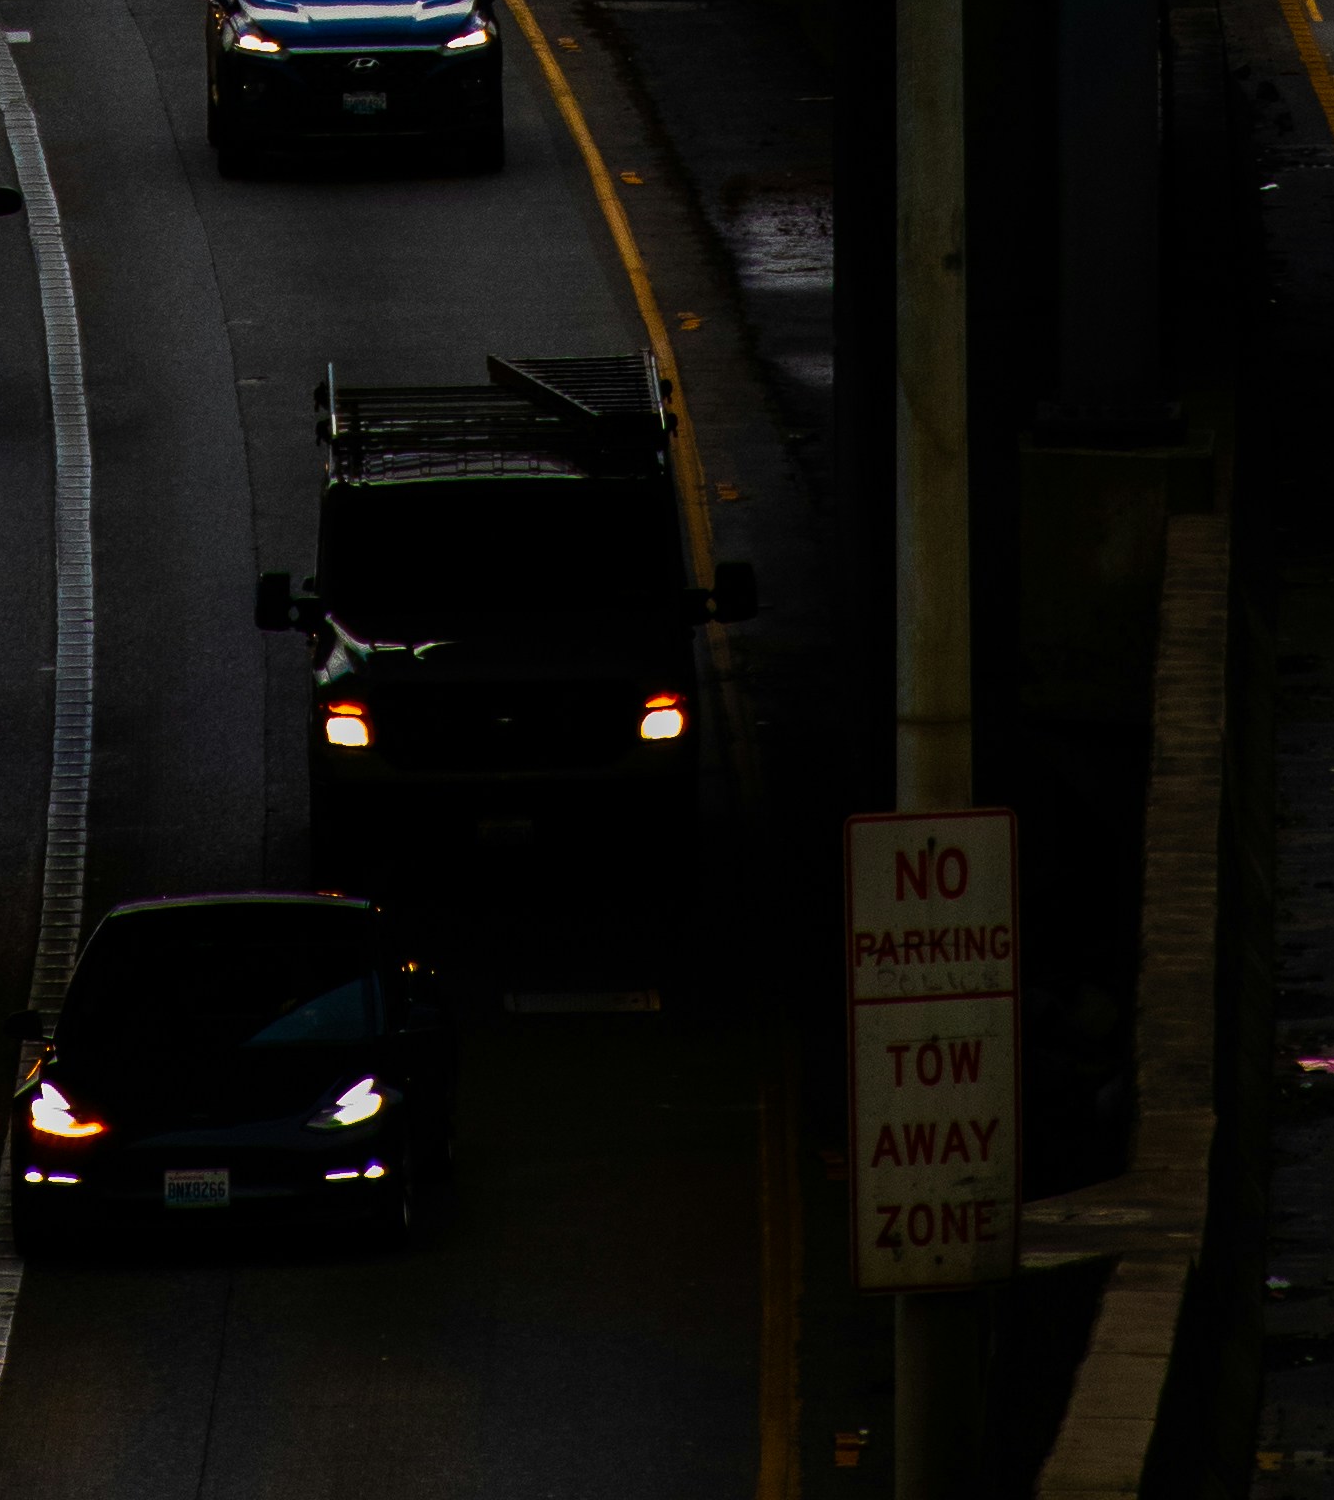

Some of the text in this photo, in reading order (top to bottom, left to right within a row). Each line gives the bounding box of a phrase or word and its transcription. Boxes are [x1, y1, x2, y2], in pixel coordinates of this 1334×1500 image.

[895, 848, 969, 900] NO
[854, 924, 1011, 968] PARKING
[886, 1040, 981, 1088] TOW
[871, 1118, 1000, 1168] AWAY
[875, 1200, 998, 1248] ZONE
